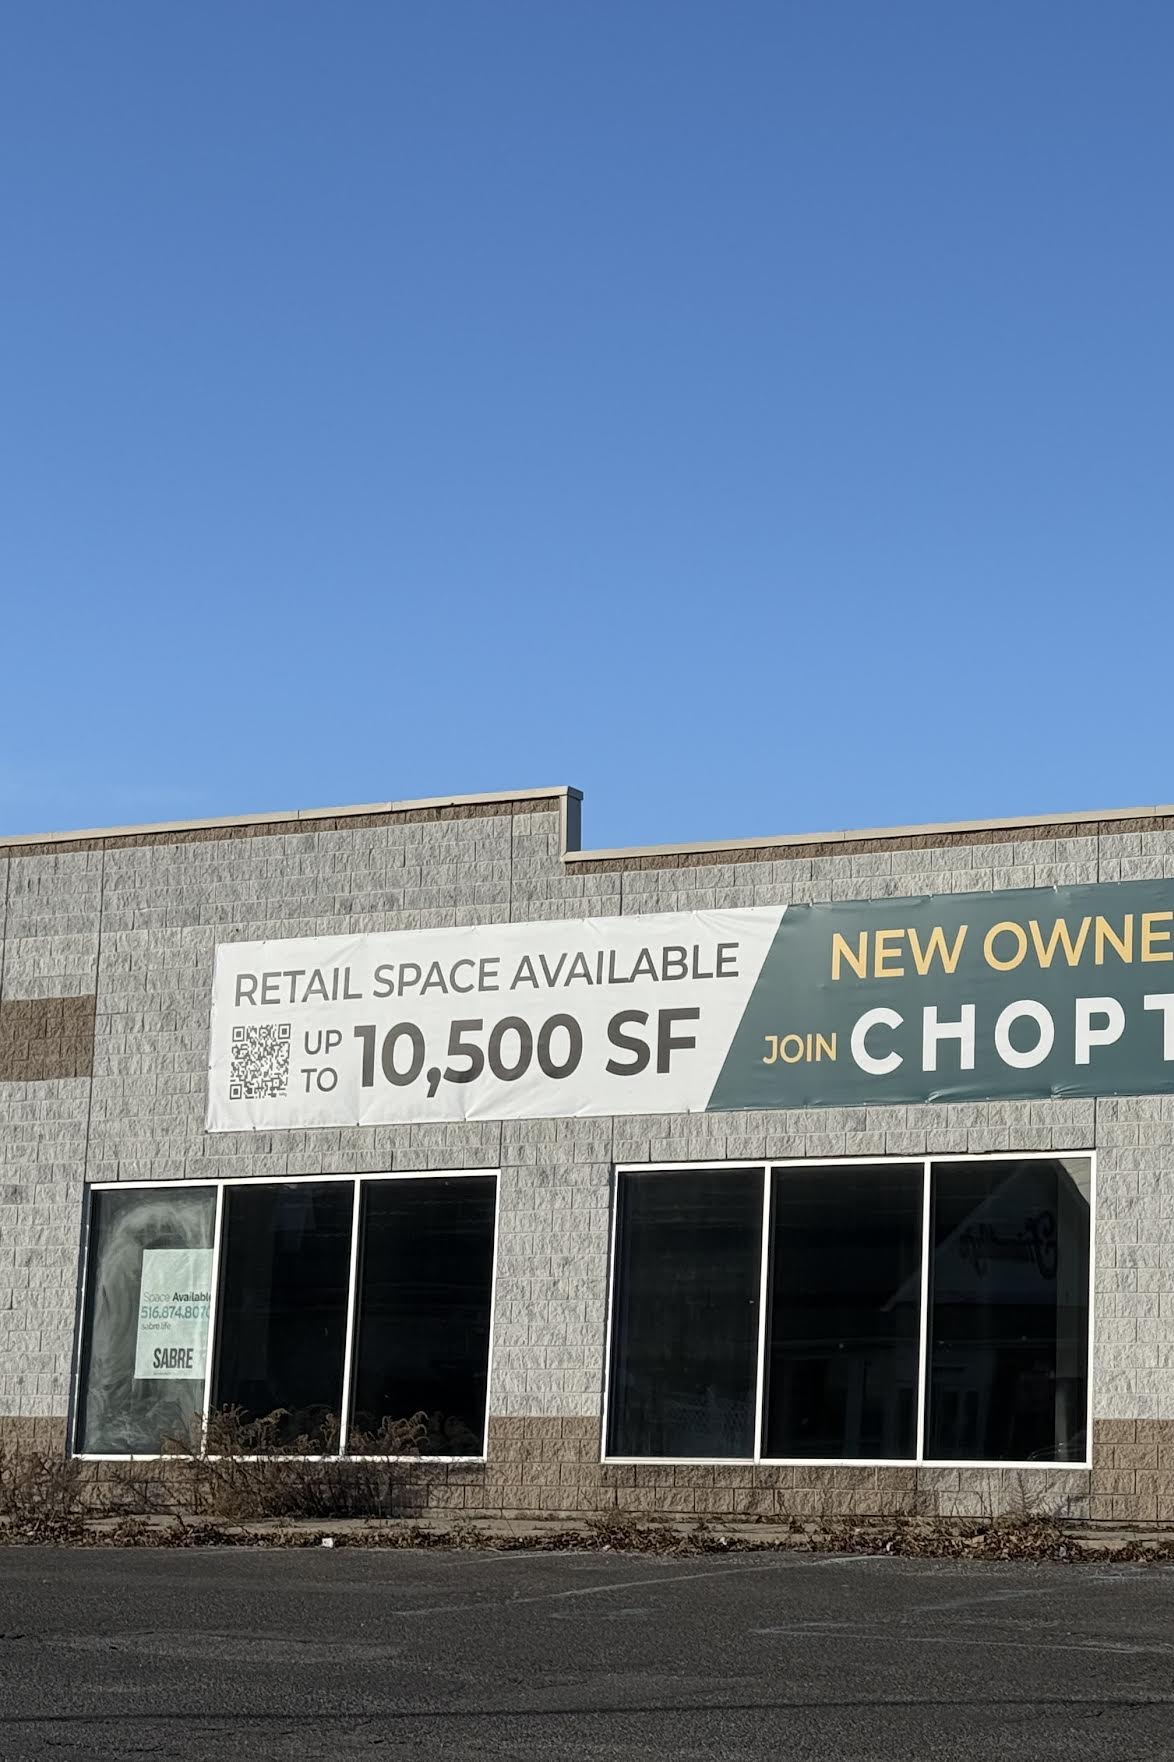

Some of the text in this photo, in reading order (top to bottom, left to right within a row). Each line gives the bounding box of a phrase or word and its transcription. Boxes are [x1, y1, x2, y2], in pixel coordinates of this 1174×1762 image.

[831, 924, 968, 981] NEW
[233, 942, 740, 1007] RETAIL SPACE AVAILABLE
[304, 1030, 343, 1056] UP
[353, 1007, 701, 1098] 10,500 SF
[762, 1032, 837, 1066] JOIN
[301, 1068, 339, 1093] TO
[143, 1291, 171, 1303] Space
[153, 1348, 194, 1369] SABRE
